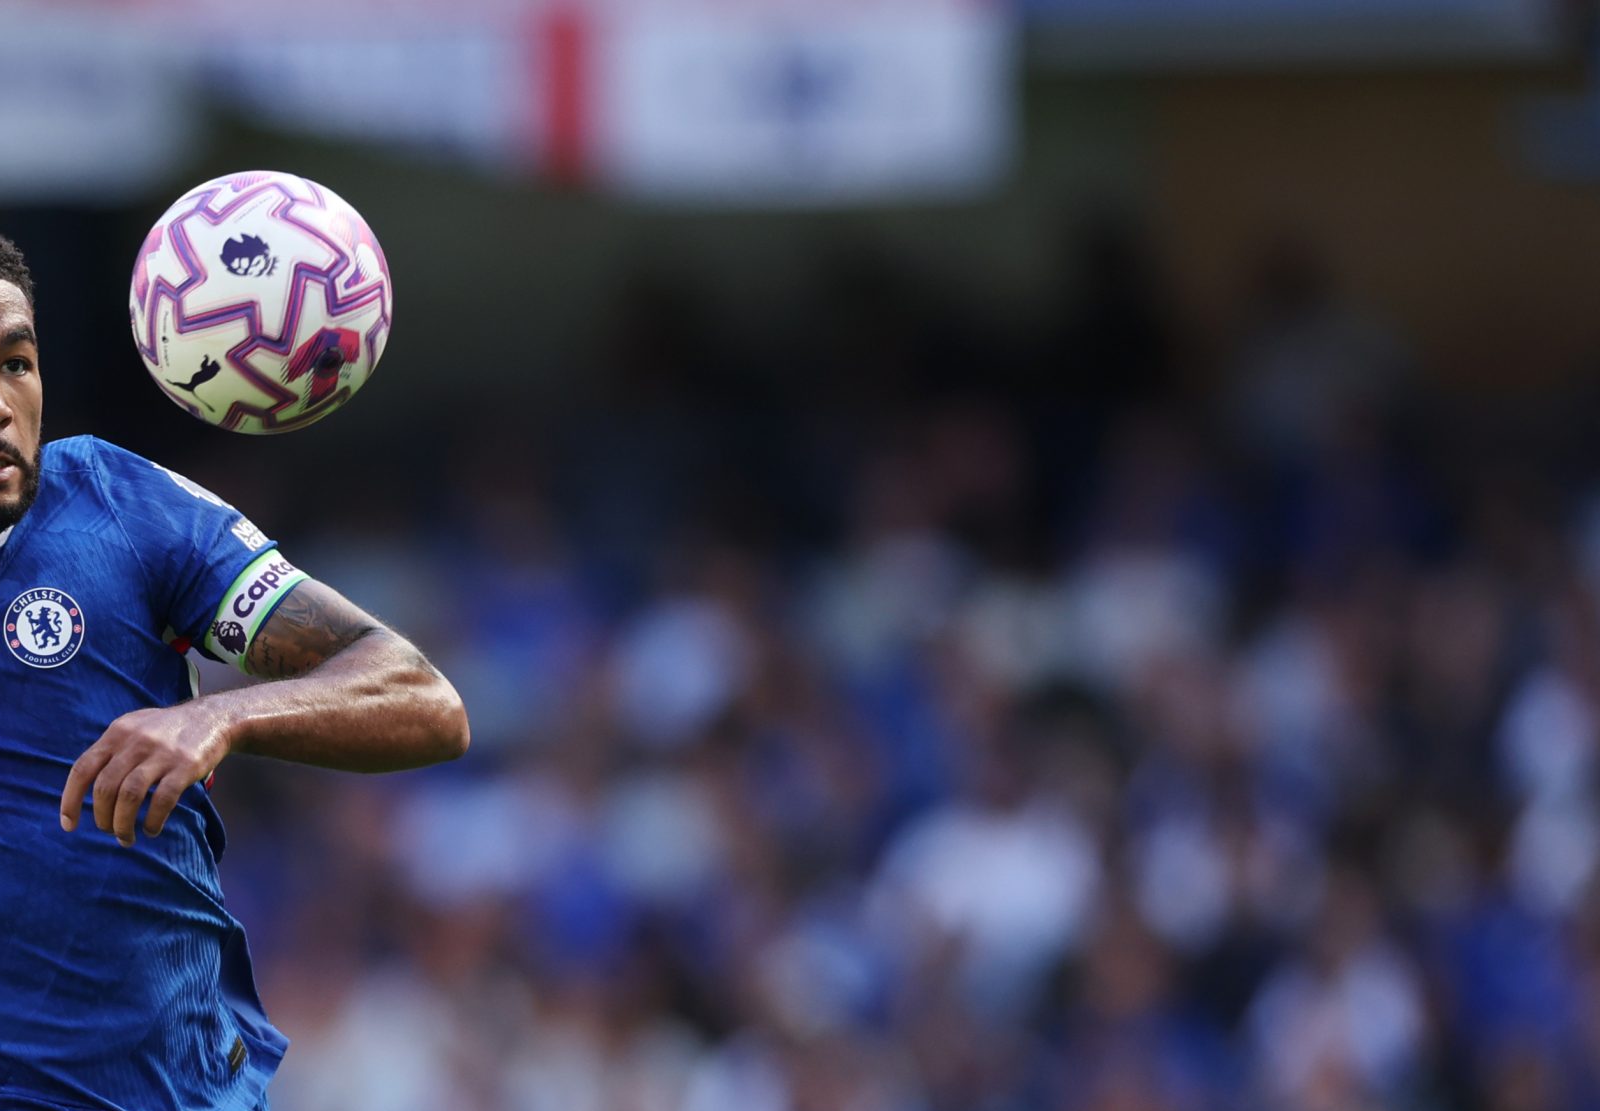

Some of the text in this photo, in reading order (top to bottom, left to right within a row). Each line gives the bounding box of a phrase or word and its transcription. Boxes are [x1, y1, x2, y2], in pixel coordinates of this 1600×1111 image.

[12, 590, 63, 613] CHELSEA
[24, 643, 76, 664] FOOTBALL CLUB
